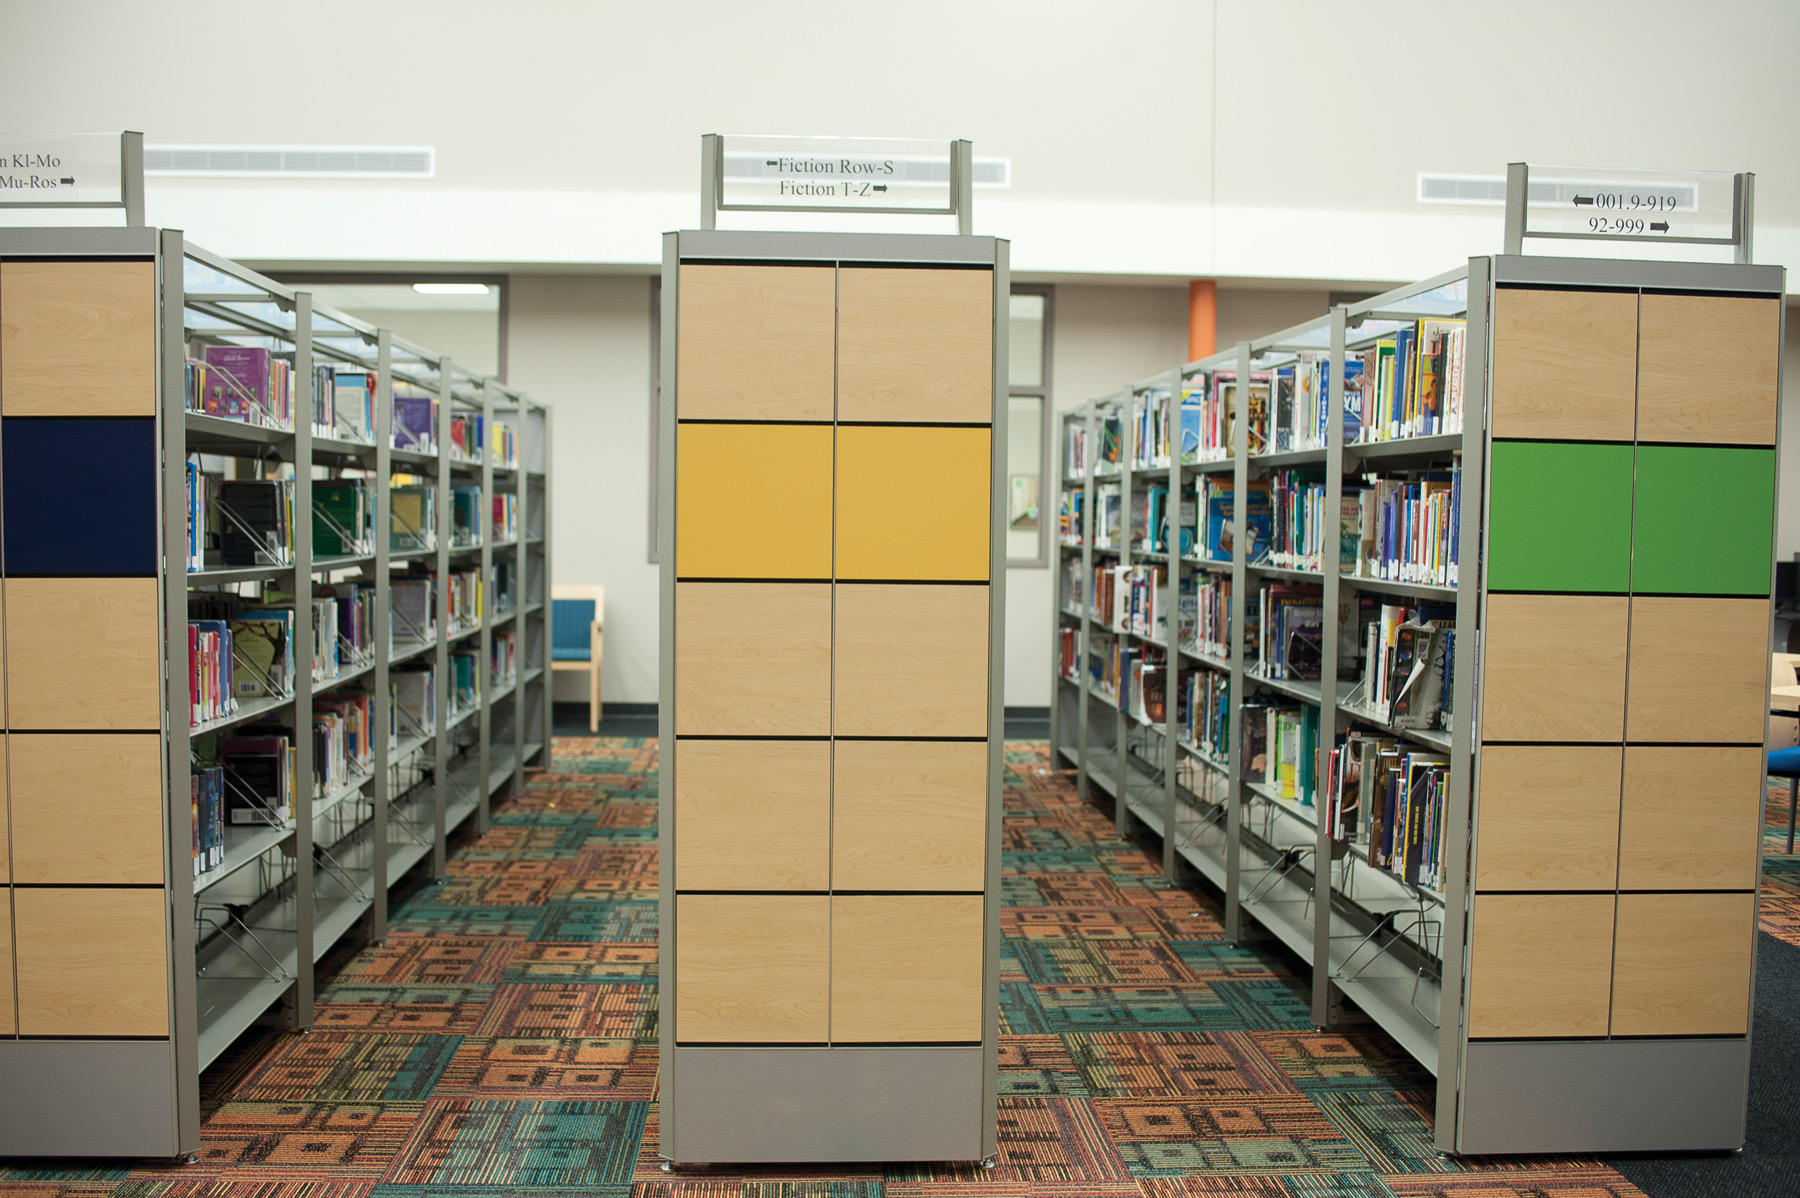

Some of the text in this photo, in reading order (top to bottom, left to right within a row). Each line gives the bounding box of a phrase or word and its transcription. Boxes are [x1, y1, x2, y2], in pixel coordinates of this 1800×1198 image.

[13, 154, 61, 168] Kl-Mo
[779, 158, 894, 175] Fiction Row-S
[0, 175, 57, 189] Mu-Ros
[780, 181, 871, 197] Fiction T-Z
[1596, 193, 1677, 212] 001.9-919
[1588, 217, 1645, 234] 92-999
